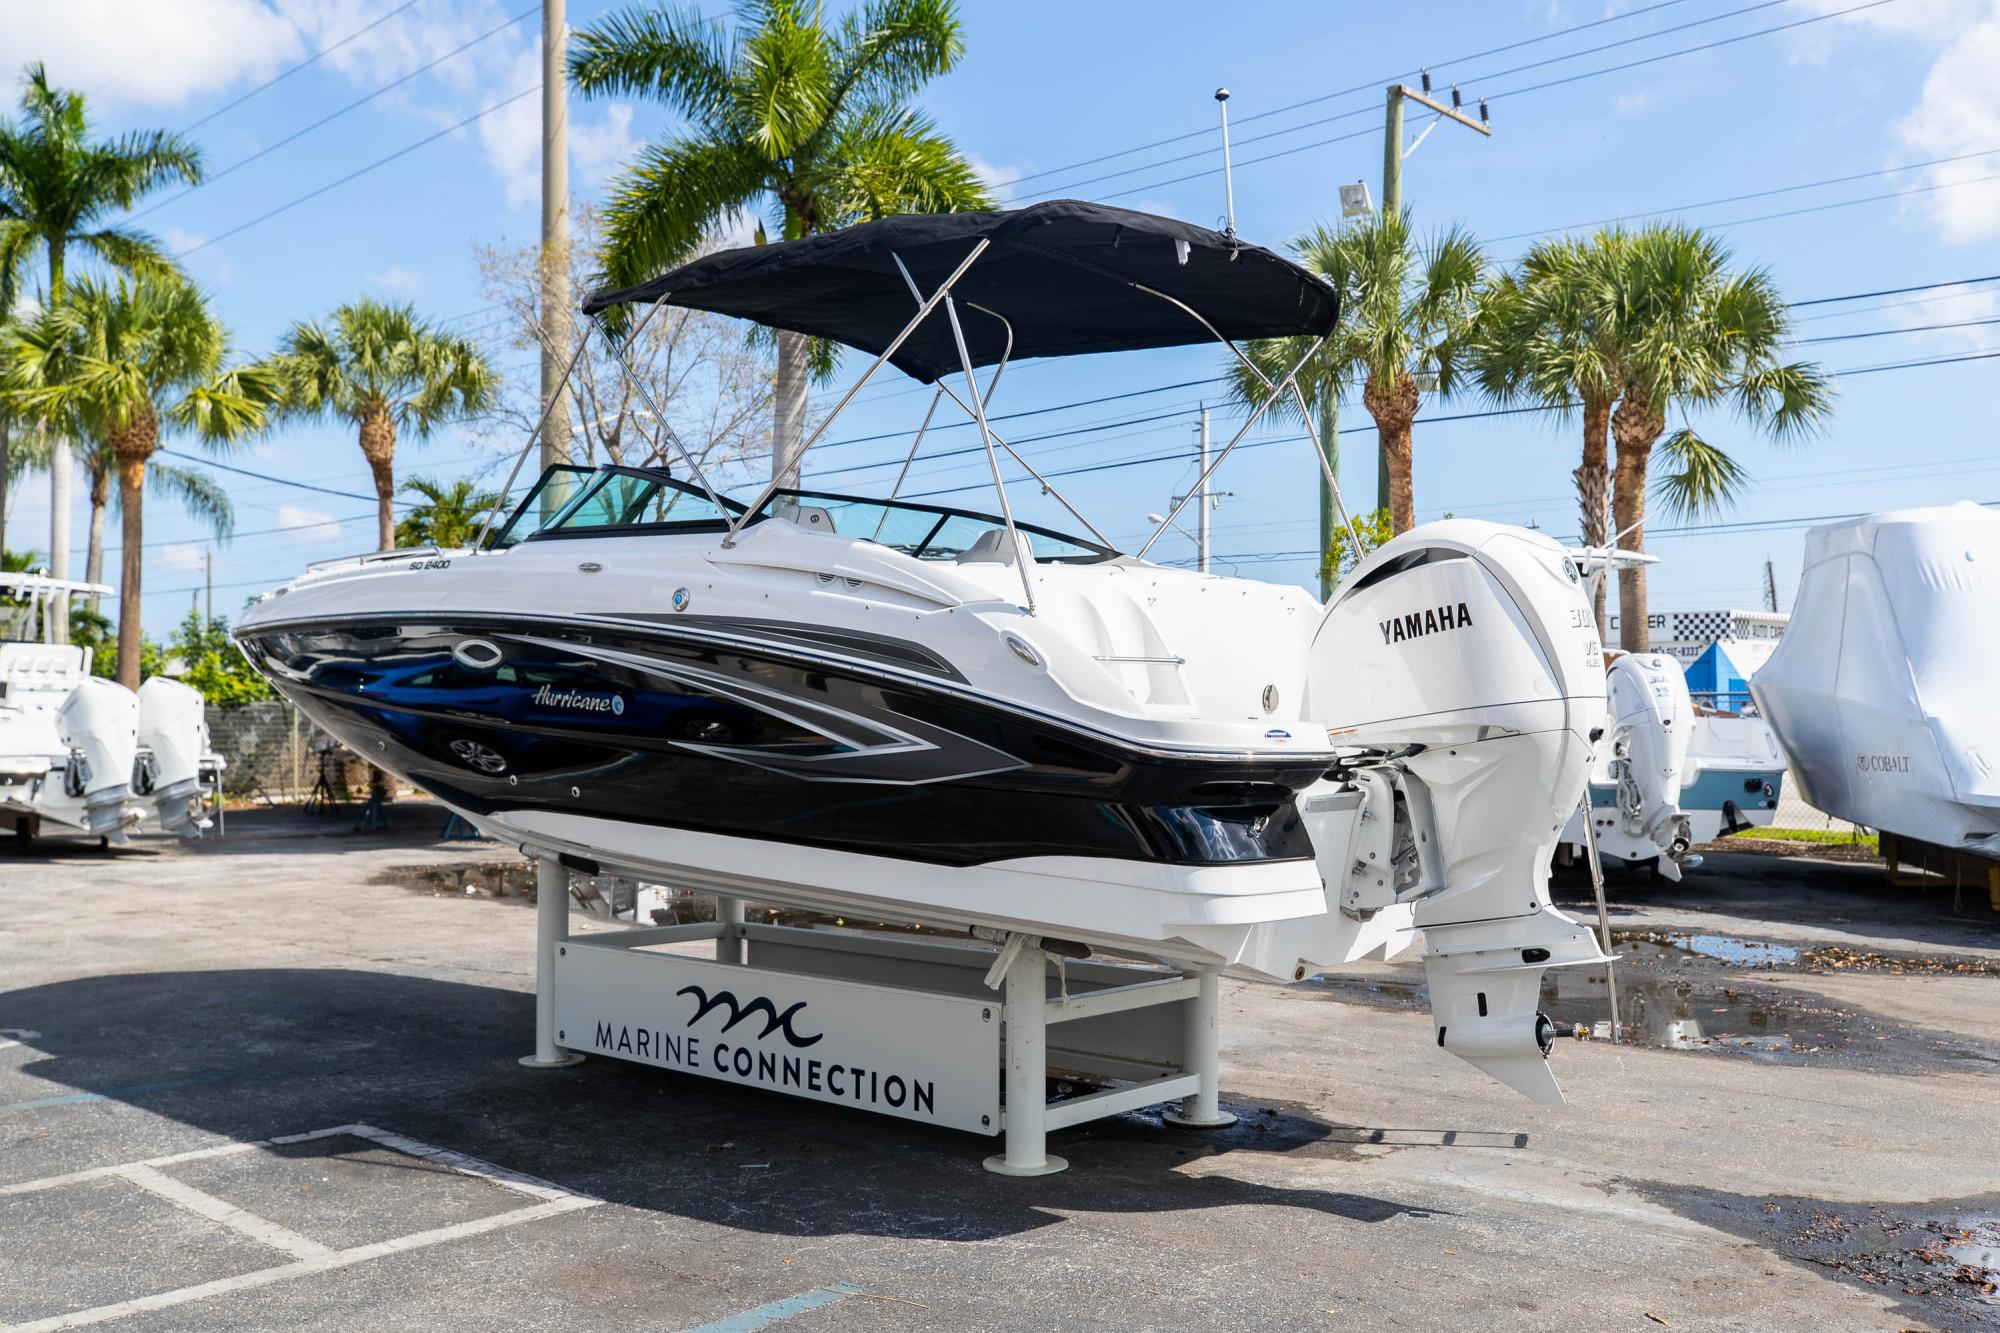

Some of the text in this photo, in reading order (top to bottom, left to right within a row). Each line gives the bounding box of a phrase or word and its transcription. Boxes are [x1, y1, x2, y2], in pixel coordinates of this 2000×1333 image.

[424, 560, 451, 570] 2400
[1379, 602, 1473, 645] YAMAHA
[531, 683, 611, 711] Hurricane
[1871, 755, 1910, 773] COBALT
[595, 1020, 935, 1115] MARINE CONNECTION
